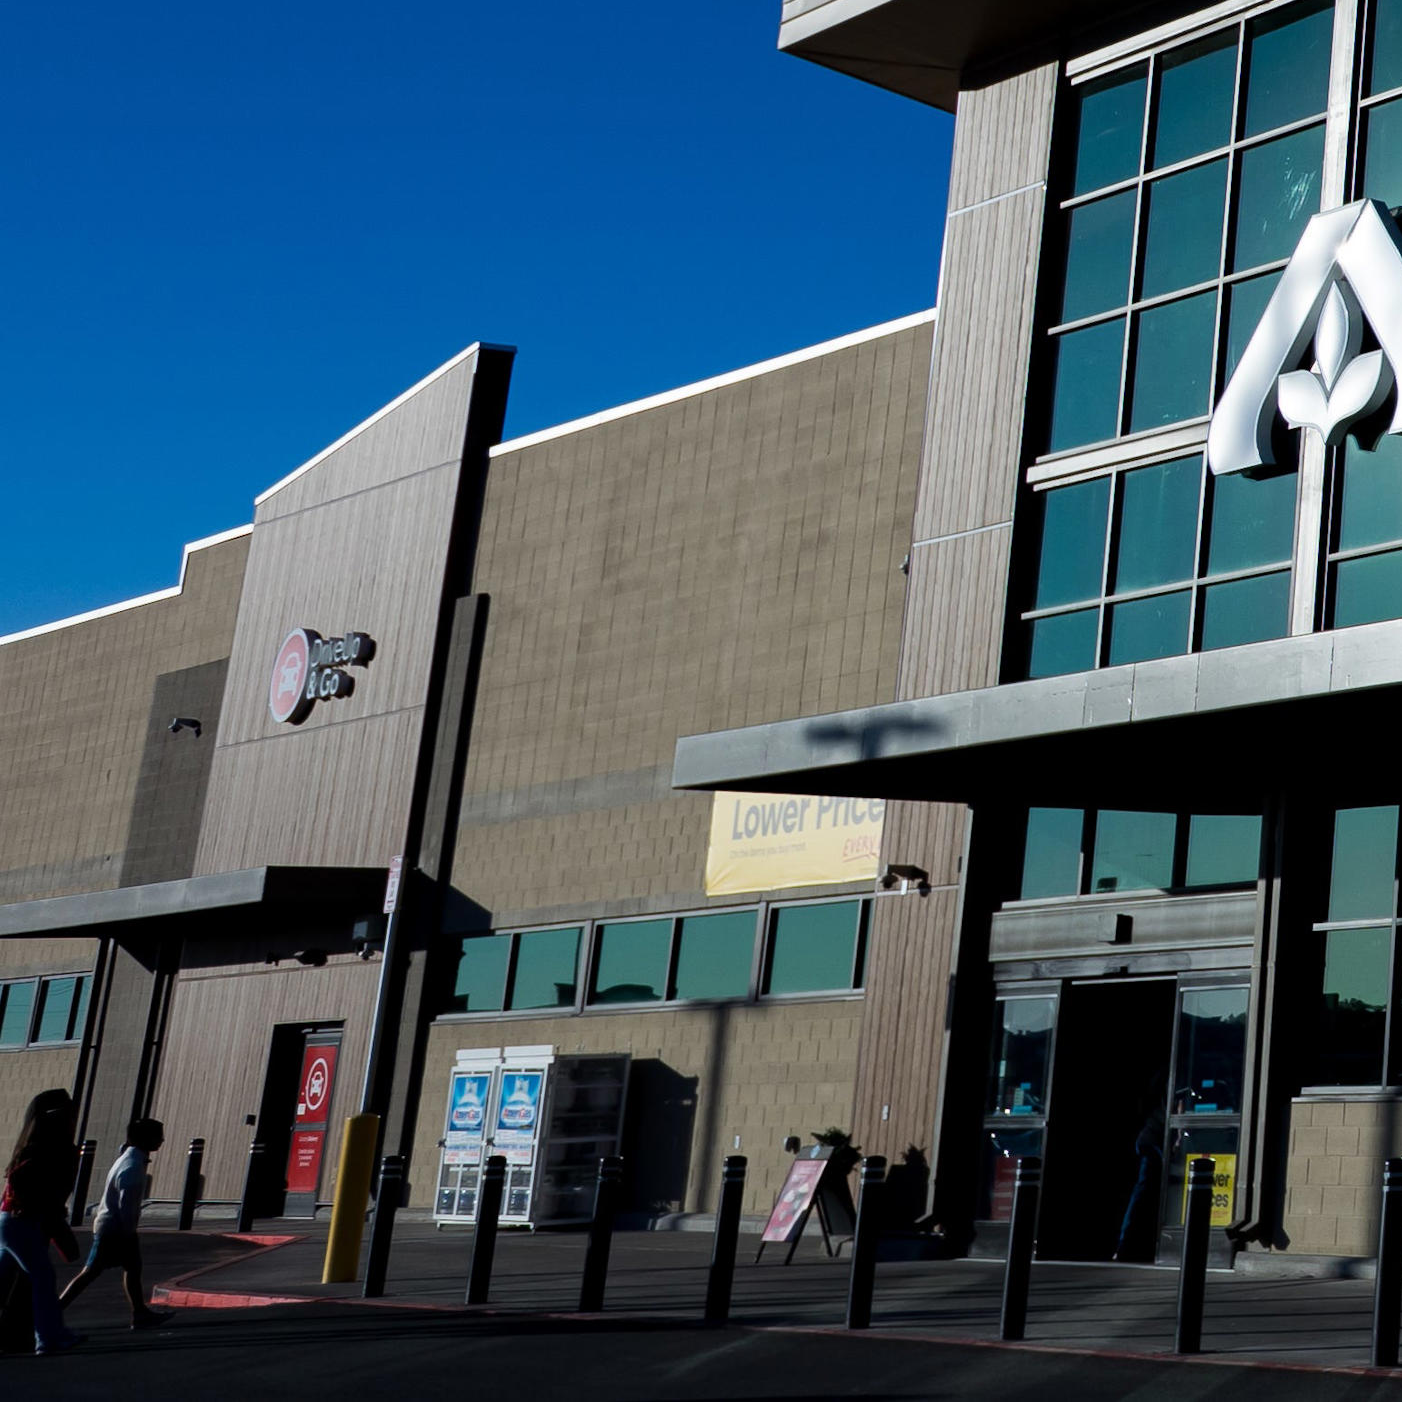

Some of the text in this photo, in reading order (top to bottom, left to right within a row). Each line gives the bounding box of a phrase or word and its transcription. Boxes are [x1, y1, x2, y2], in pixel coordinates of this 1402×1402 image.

[307, 667, 340, 699] & Go
[732, 798, 811, 840] Lower
